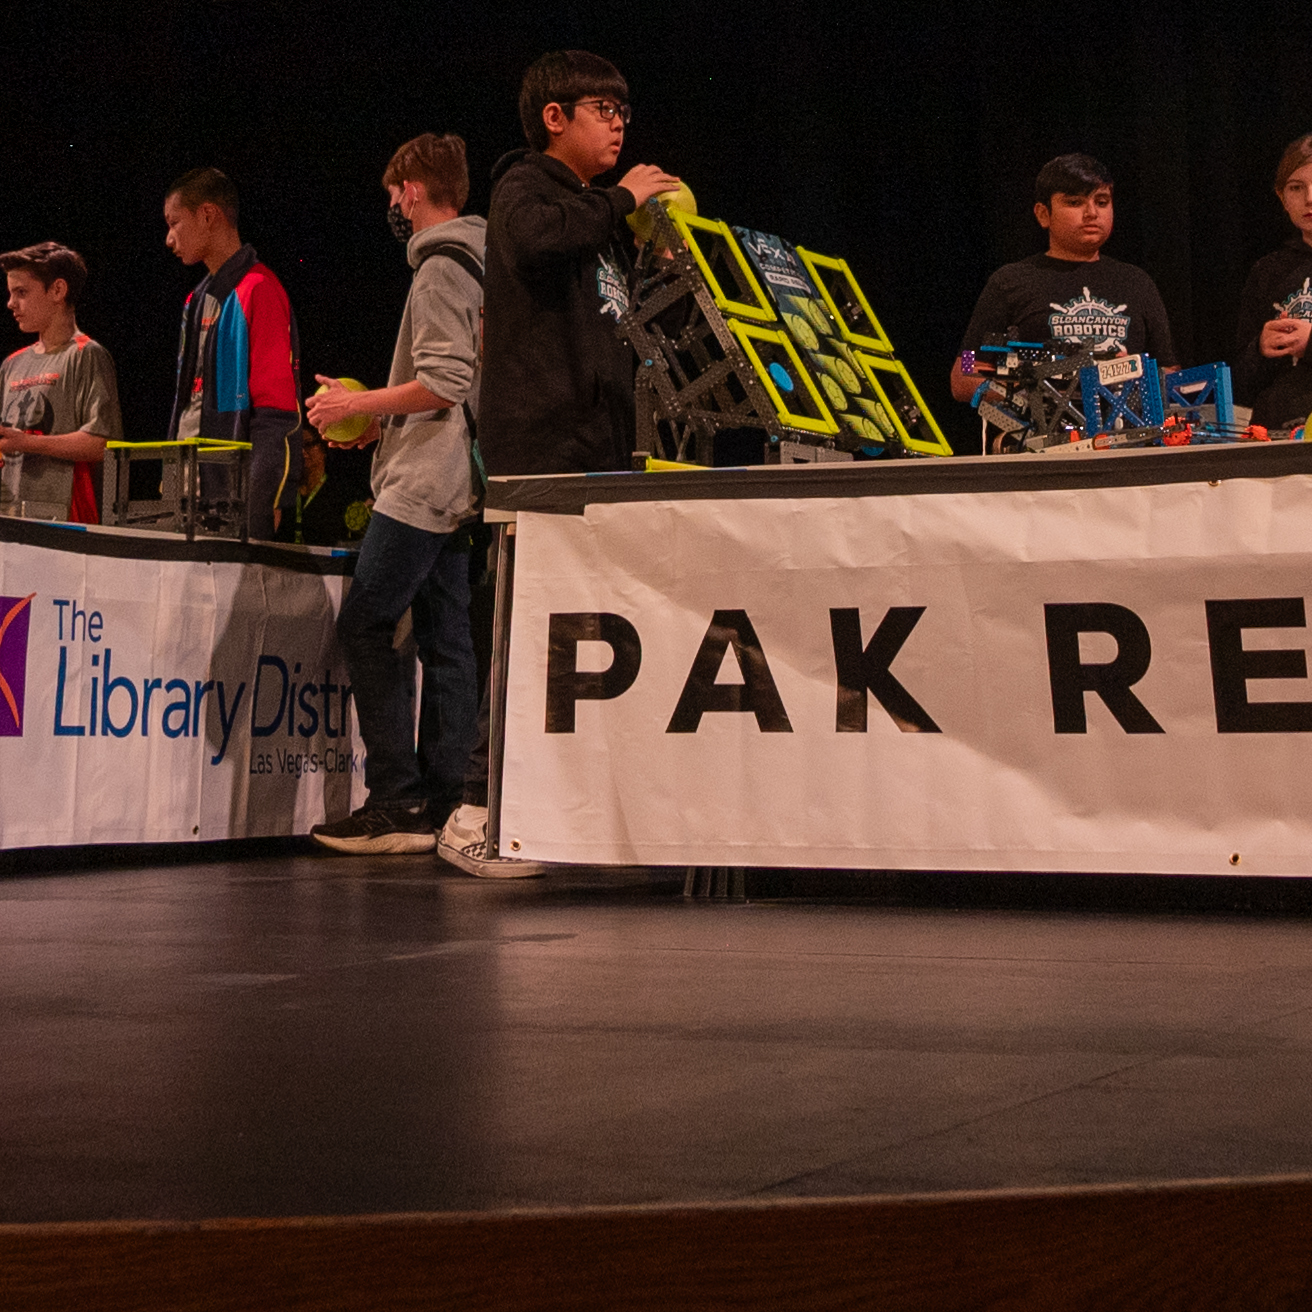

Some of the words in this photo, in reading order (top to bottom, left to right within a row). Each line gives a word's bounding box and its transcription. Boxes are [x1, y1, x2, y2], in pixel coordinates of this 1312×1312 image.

[1053, 324, 1126, 338] ROBOTICS
[53, 599, 104, 643] The
[545, 605, 943, 736] PAK
[53, 645, 247, 766] Library
[250, 748, 273, 775] Las
[276, 747, 358, 780] Vegas-Clark
